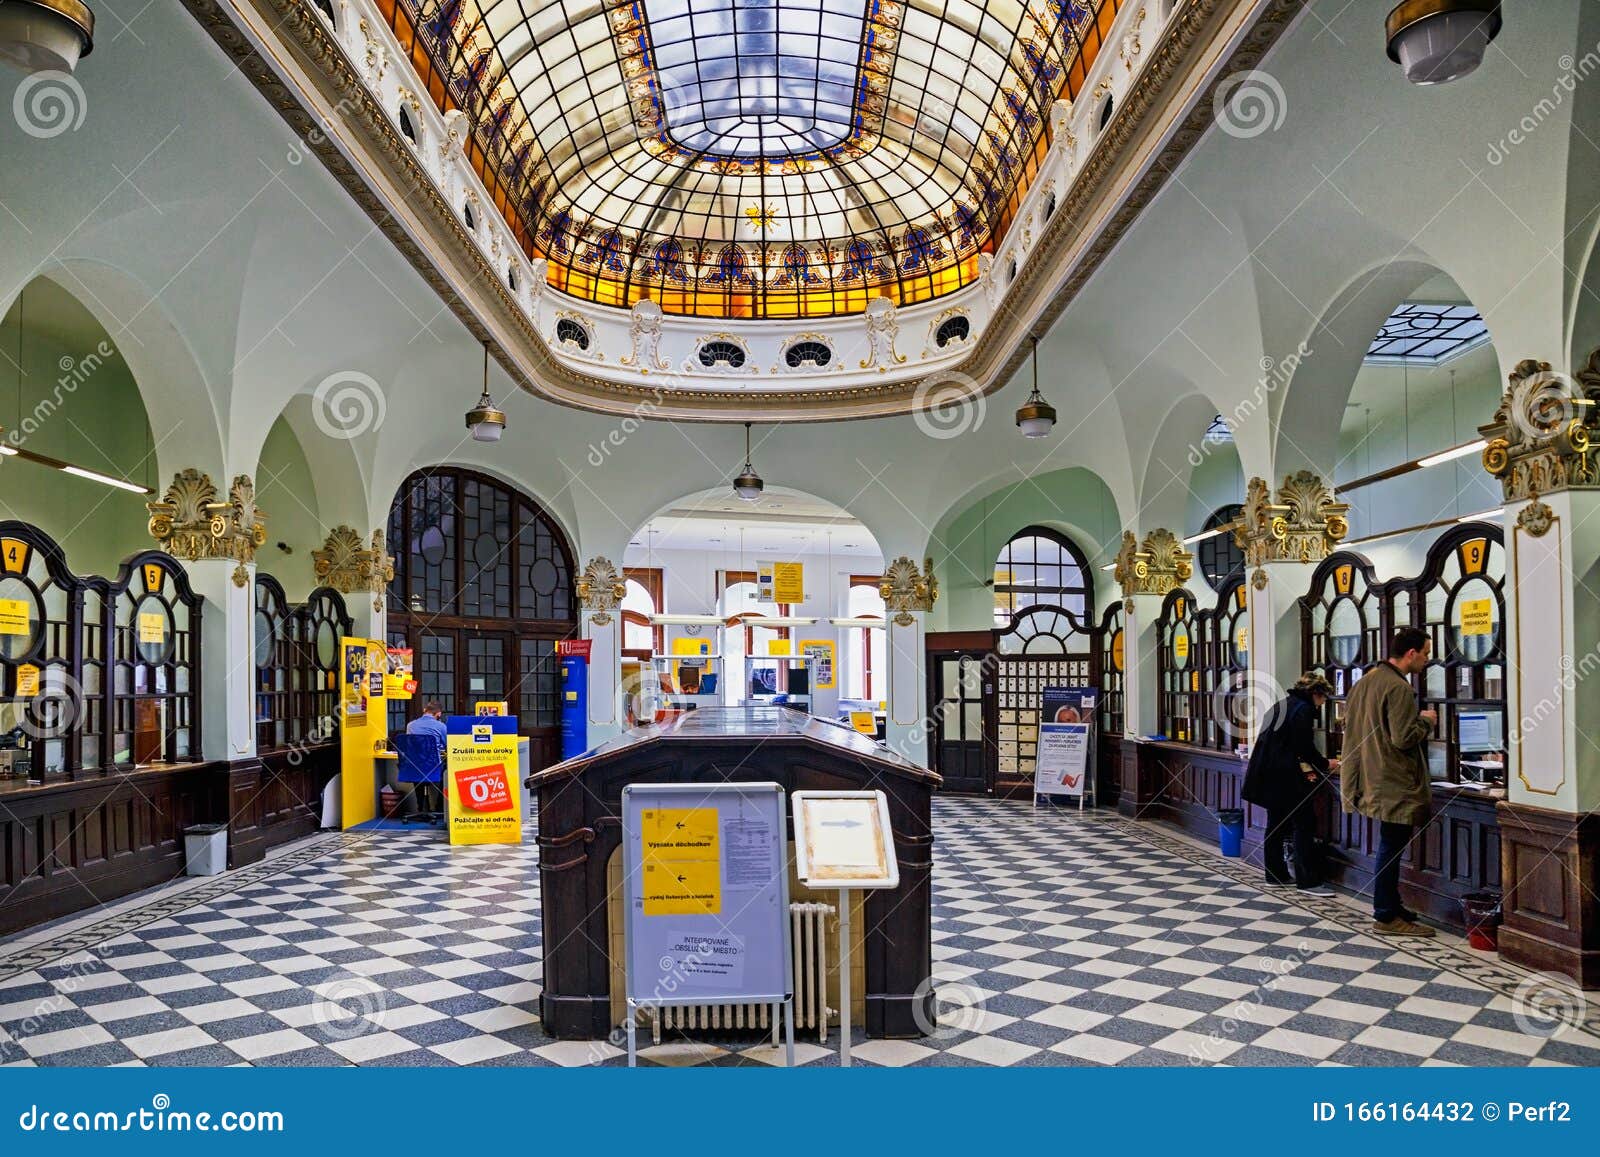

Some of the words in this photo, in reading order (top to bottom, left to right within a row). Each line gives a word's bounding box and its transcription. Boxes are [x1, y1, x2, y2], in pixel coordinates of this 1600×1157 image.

[8, 547, 17, 562] 4
[1471, 547, 1480, 563] 9
[149, 570, 156, 583] 5
[1342, 572, 1348, 585] 8
[470, 776, 505, 803] 0%
[648, 841, 674, 849] Výplata
[684, 936, 730, 946] INTEGROVANÉ
[713, 946, 738, 955] MIESTO
